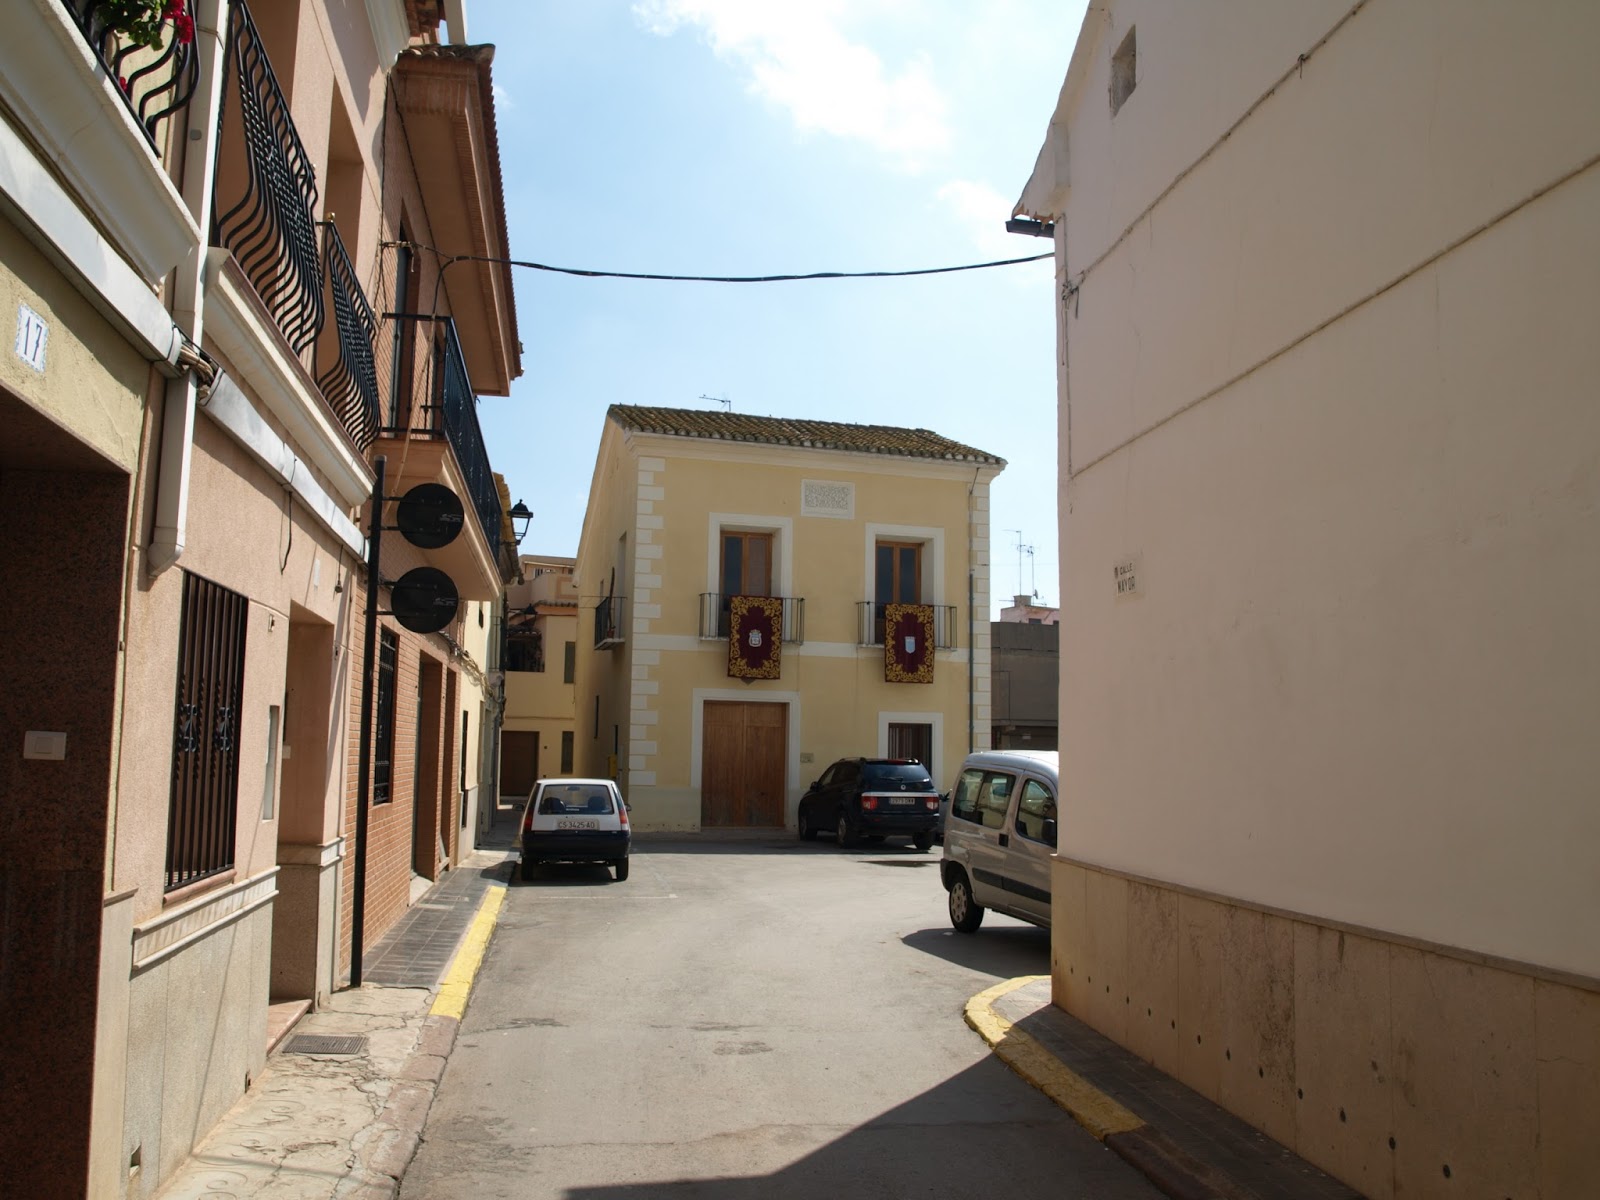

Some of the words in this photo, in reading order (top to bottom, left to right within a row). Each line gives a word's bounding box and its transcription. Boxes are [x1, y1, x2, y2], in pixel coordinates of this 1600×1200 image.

[24, 315, 43, 362] 17
[1119, 562, 1133, 576] CALLE
[1117, 575, 1136, 593] MAYOR
